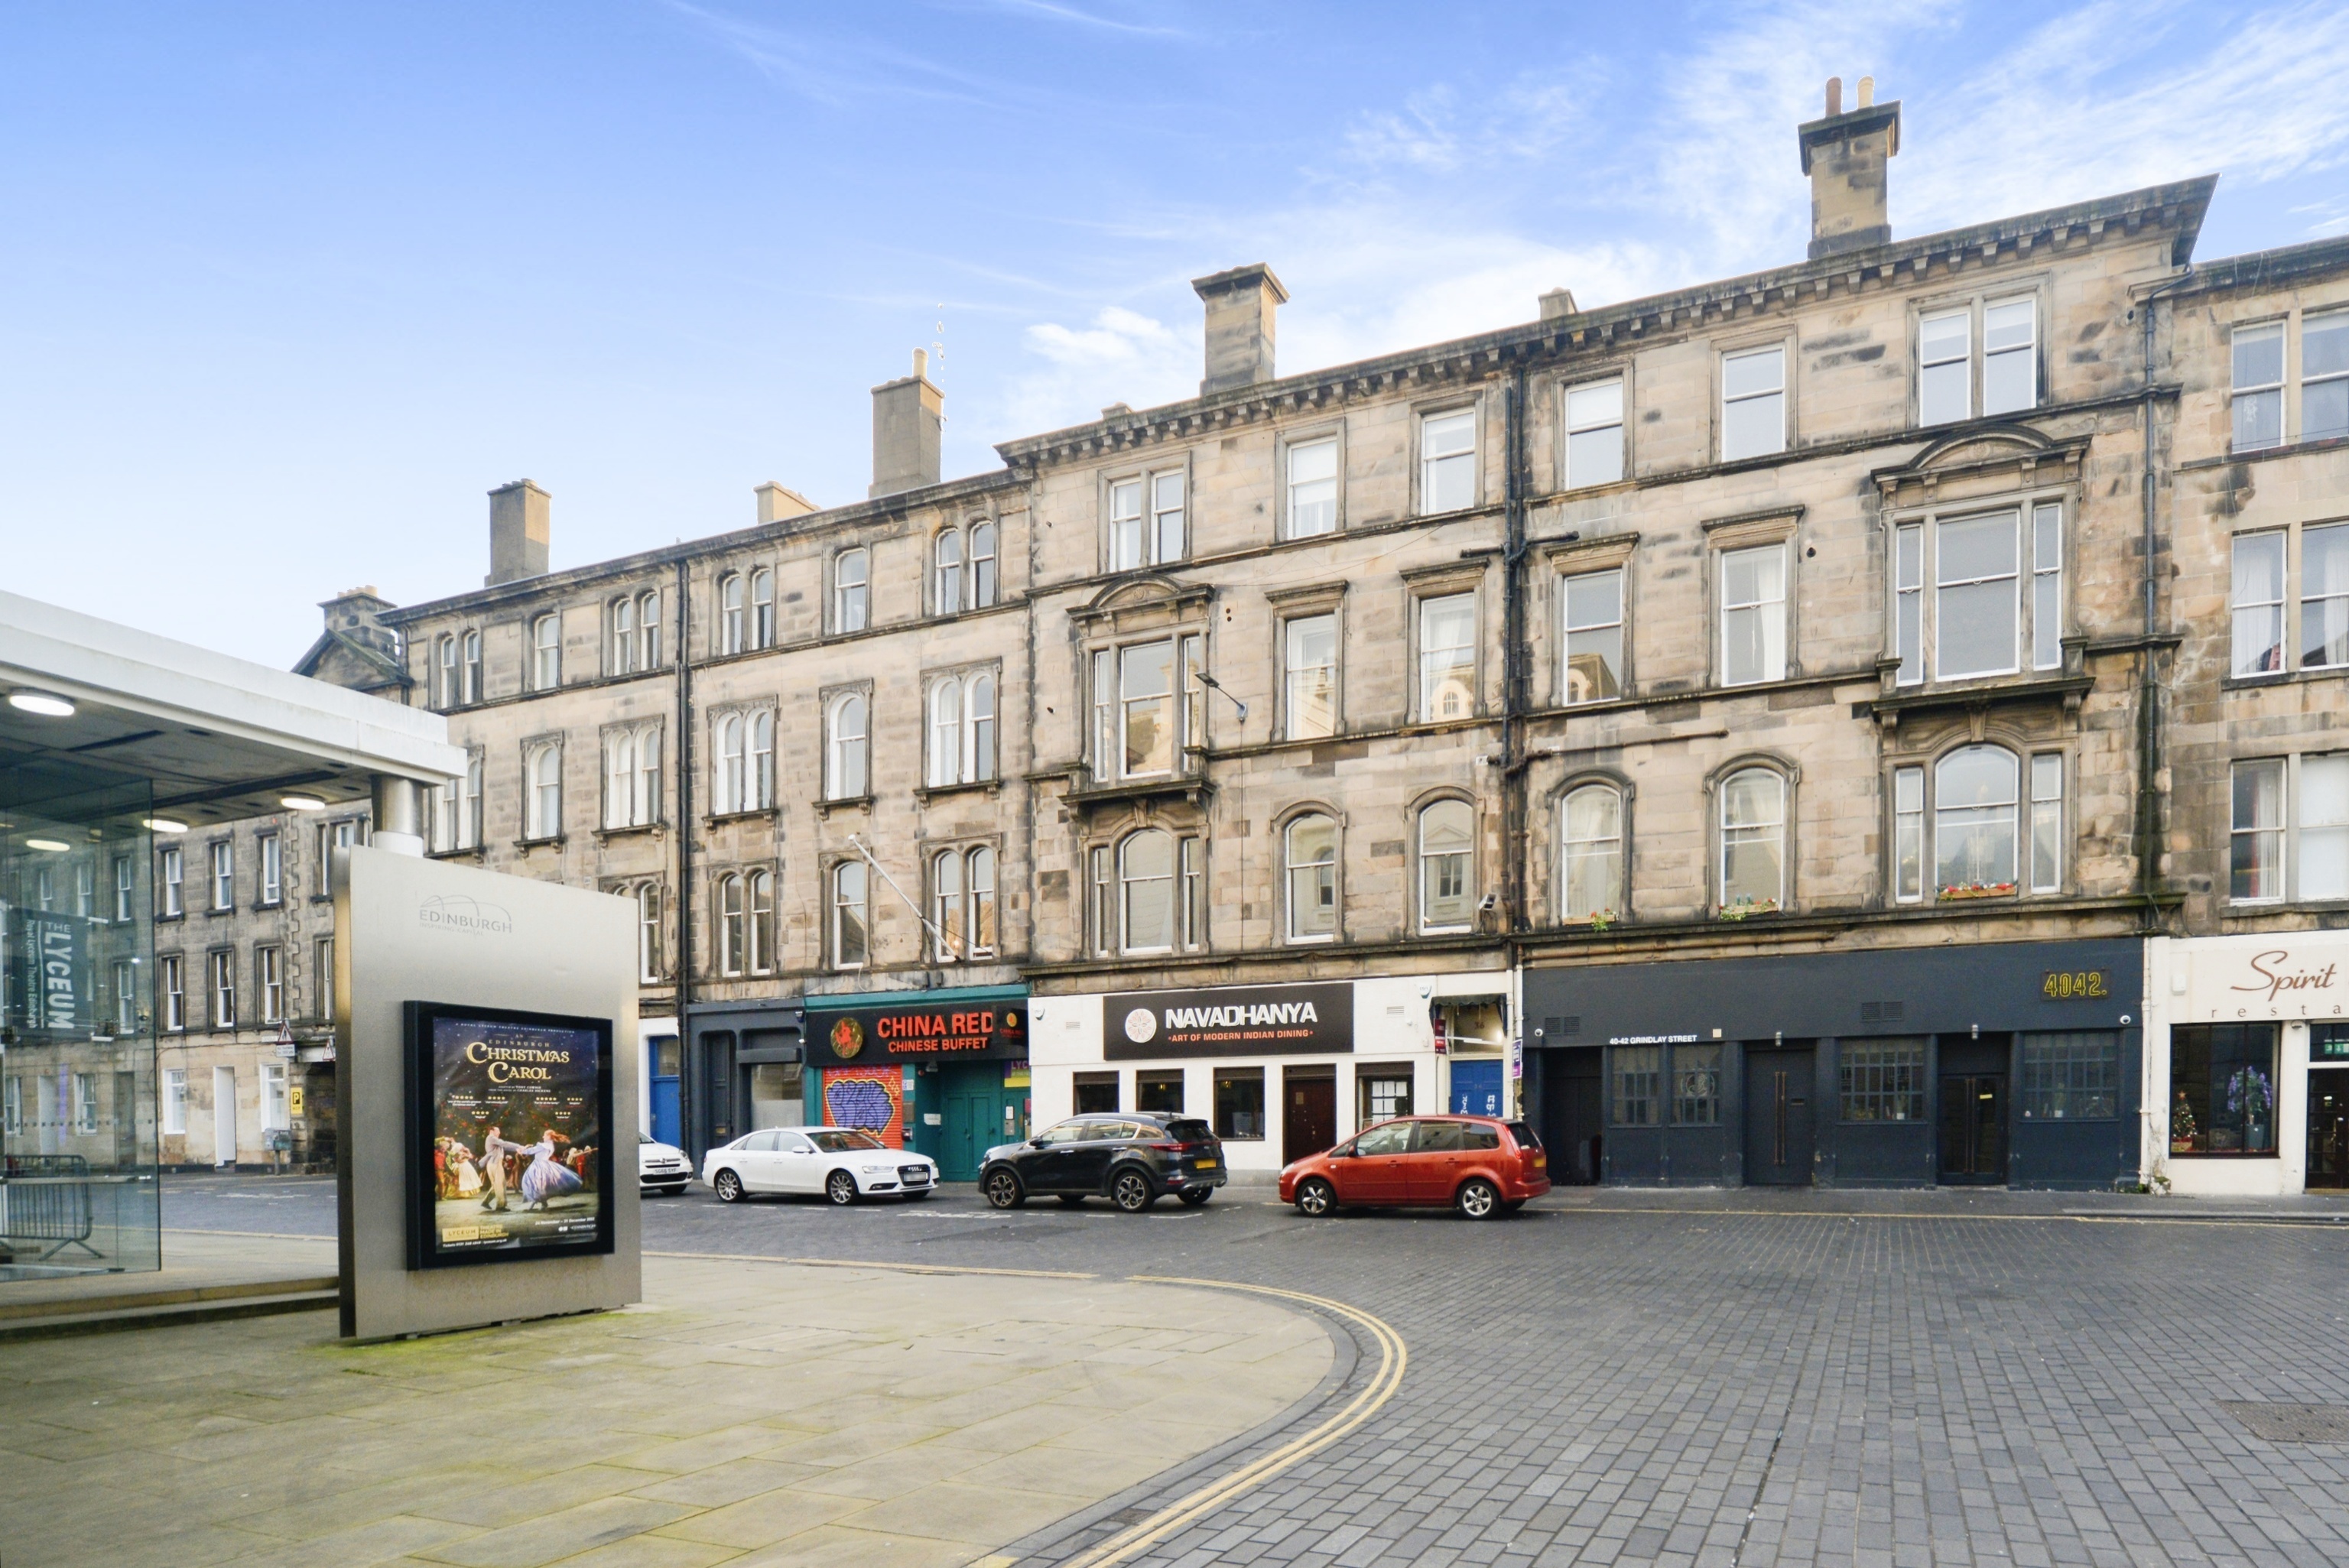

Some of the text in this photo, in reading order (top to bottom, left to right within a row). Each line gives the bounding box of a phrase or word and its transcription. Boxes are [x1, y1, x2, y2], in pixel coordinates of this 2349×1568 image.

[46, 921, 71, 933] THE
[419, 909, 512, 933] EDINBURGH
[419, 922, 454, 933] INSPIRING
[25, 919, 37, 1028] Royal Lyceum Theatre Edinburgh
[44, 932, 75, 1029] LYCEUM
[2230, 950, 2336, 1002] Spirit
[877, 1011, 993, 1038] CHINA RED
[1165, 1002, 1317, 1029] NAVADHANYA
[489, 1039, 550, 1047] EDINBURGH
[889, 1037, 988, 1053] CHINESE BUFFET
[1243, 1031, 1275, 1039] INDIAN
[1277, 1029, 1308, 1038] DINING
[1629, 1036, 1667, 1044] GRINDLAY
[1668, 1034, 1698, 1043] STREET
[466, 1041, 570, 1063] CHRISTMAS
[488, 1061, 551, 1083] CAROL
